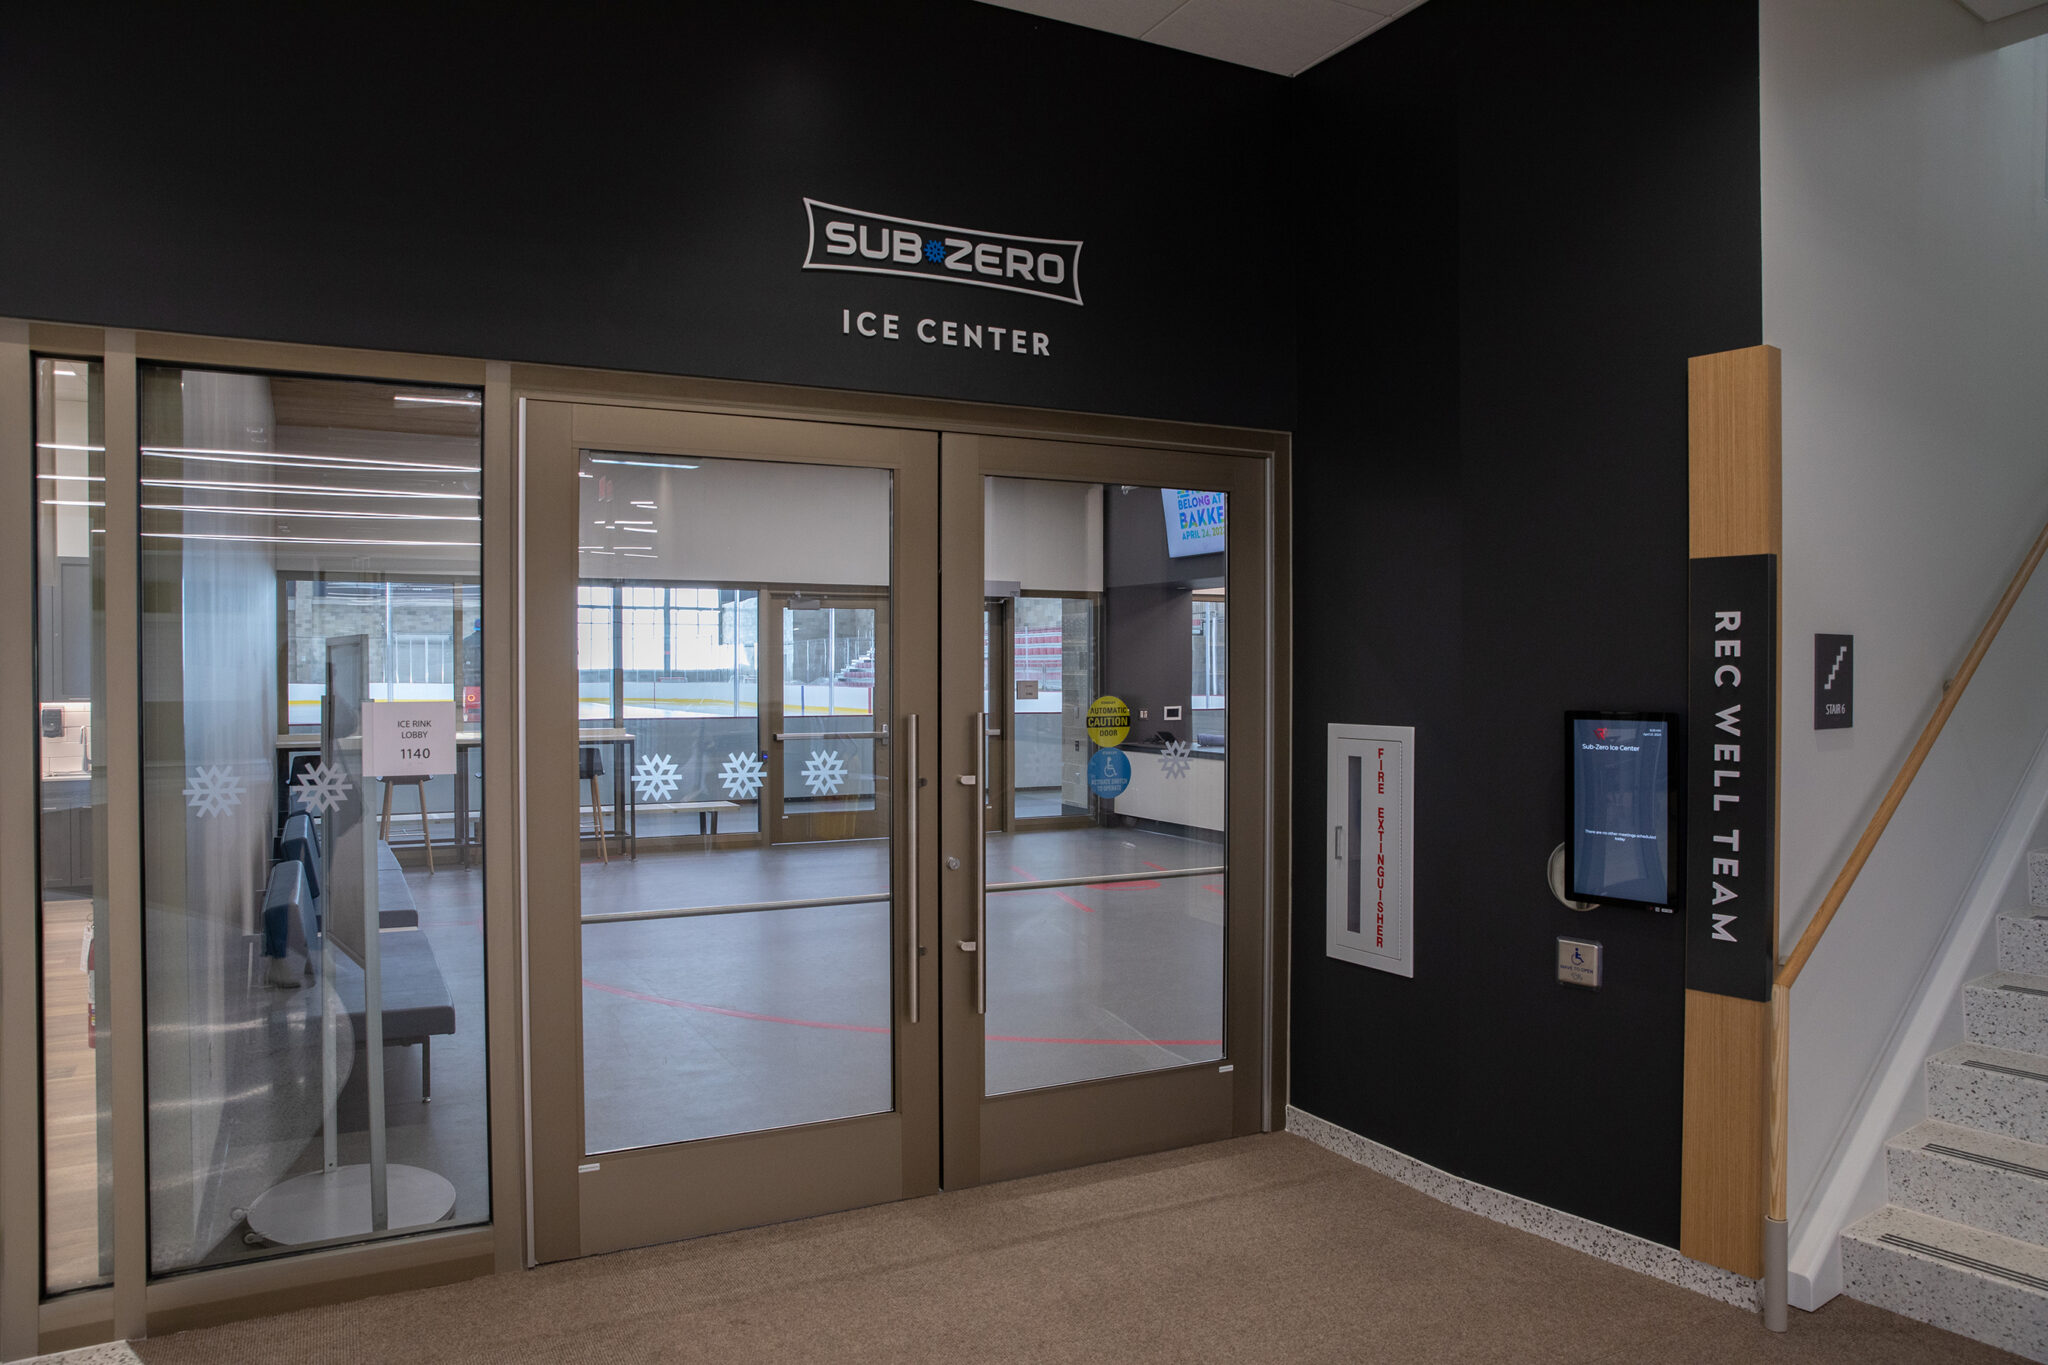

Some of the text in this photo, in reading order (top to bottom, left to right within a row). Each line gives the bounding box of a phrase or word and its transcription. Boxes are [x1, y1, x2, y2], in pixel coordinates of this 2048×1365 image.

[825, 220, 1065, 285] SUB ZERO
[843, 309, 1050, 357] ICE CENTER
[1177, 492, 1222, 511] BELONG AT
[1179, 505, 1225, 530] BAKKE
[1182, 529, 1201, 541] APRIL
[1090, 706, 1127, 714] AUTOMATIC
[1825, 703, 1841, 715] STAIR
[397, 720, 432, 728] ICE RINK
[1088, 716, 1128, 727] CAUTION
[401, 731, 428, 739] LOBBY
[1099, 729, 1118, 737] DOOR
[1582, 743, 1609, 751] Sub-Zero
[400, 748, 431, 760] 1140
[1711, 610, 1742, 943] REC WELL TEAM
[1376, 747, 1385, 948] FIRE EXTINGUISHER
